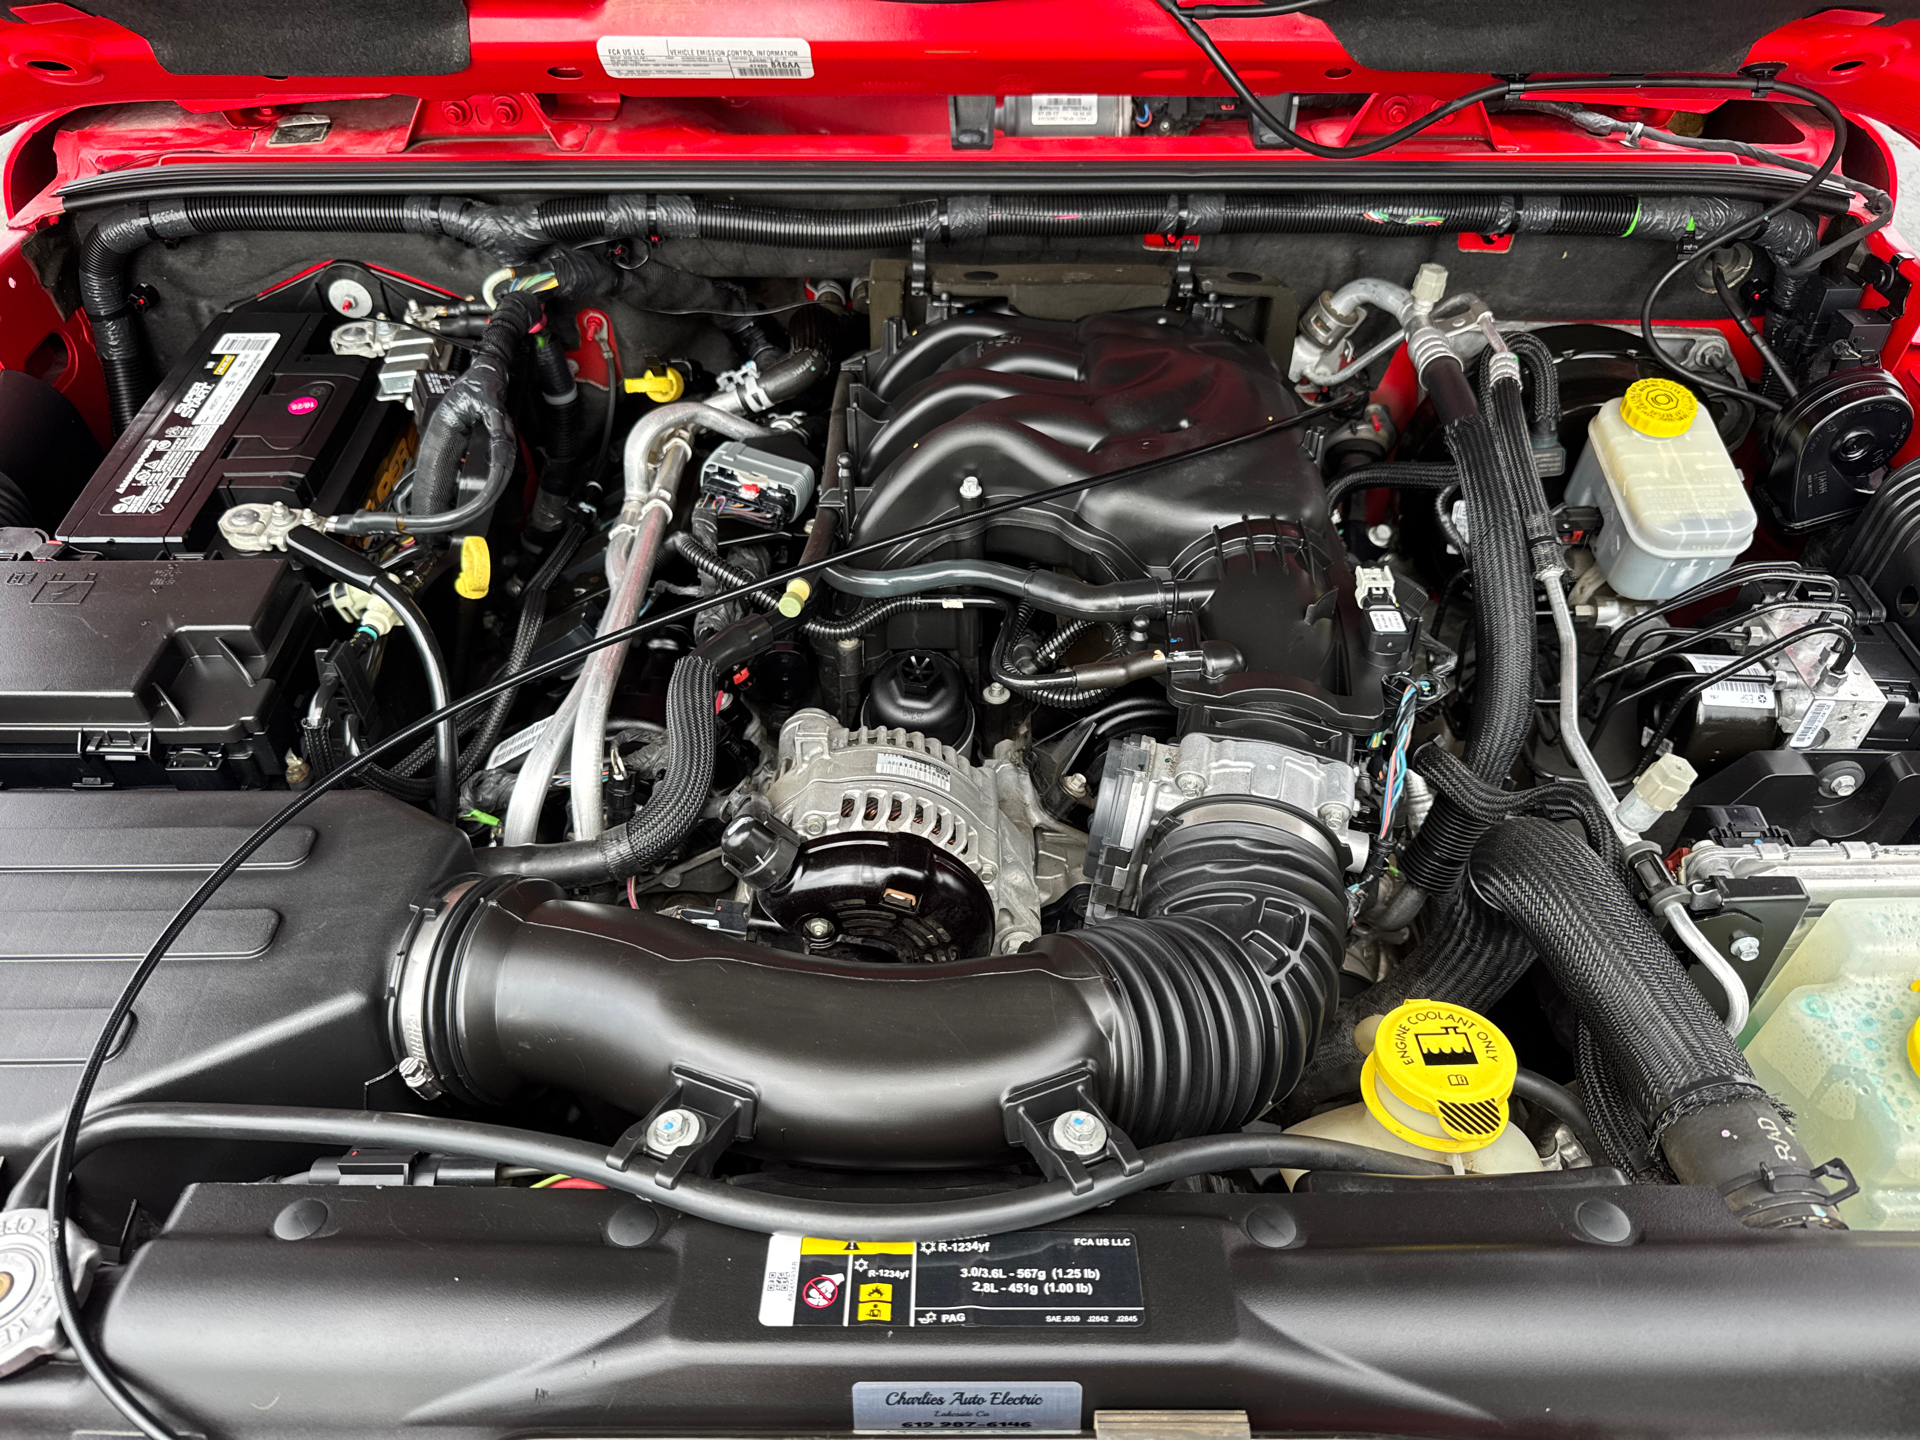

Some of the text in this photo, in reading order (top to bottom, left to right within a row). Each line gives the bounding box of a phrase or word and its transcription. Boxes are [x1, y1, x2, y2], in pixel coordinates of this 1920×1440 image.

[174, 381, 206, 414] SUPER
[180, 382, 216, 419] START
[291, 401, 316, 412] 10/25
[1395, 1011, 1499, 1066] ENGINE COOLANT ONLY
[1757, 1116, 1797, 1162] RAD
[938, 1240, 991, 1254] R-1234yf
[1074, 1238, 1131, 1247] FCA US LLC
[868, 1269, 910, 1280] R-1234yf
[960, 1267, 1008, 1279] 3.0/3.6L
[1016, 1268, 1046, 1280] 567g
[1052, 1268, 1082, 1280] (1.25
[1083, 1268, 1101, 1280] lb)
[971, 1282, 999, 1293] 2.8L
[1008, 1283, 1039, 1295] 451g
[1043, 1282, 1074, 1295] (1.00
[1076, 1282, 1093, 1295] lb)
[941, 1313, 966, 1323] PAG
[1045, 1315, 1138, 1323] SAE J639 J2842 J2845
[885, 1391, 1044, 1407] Charlies Auto Electric
